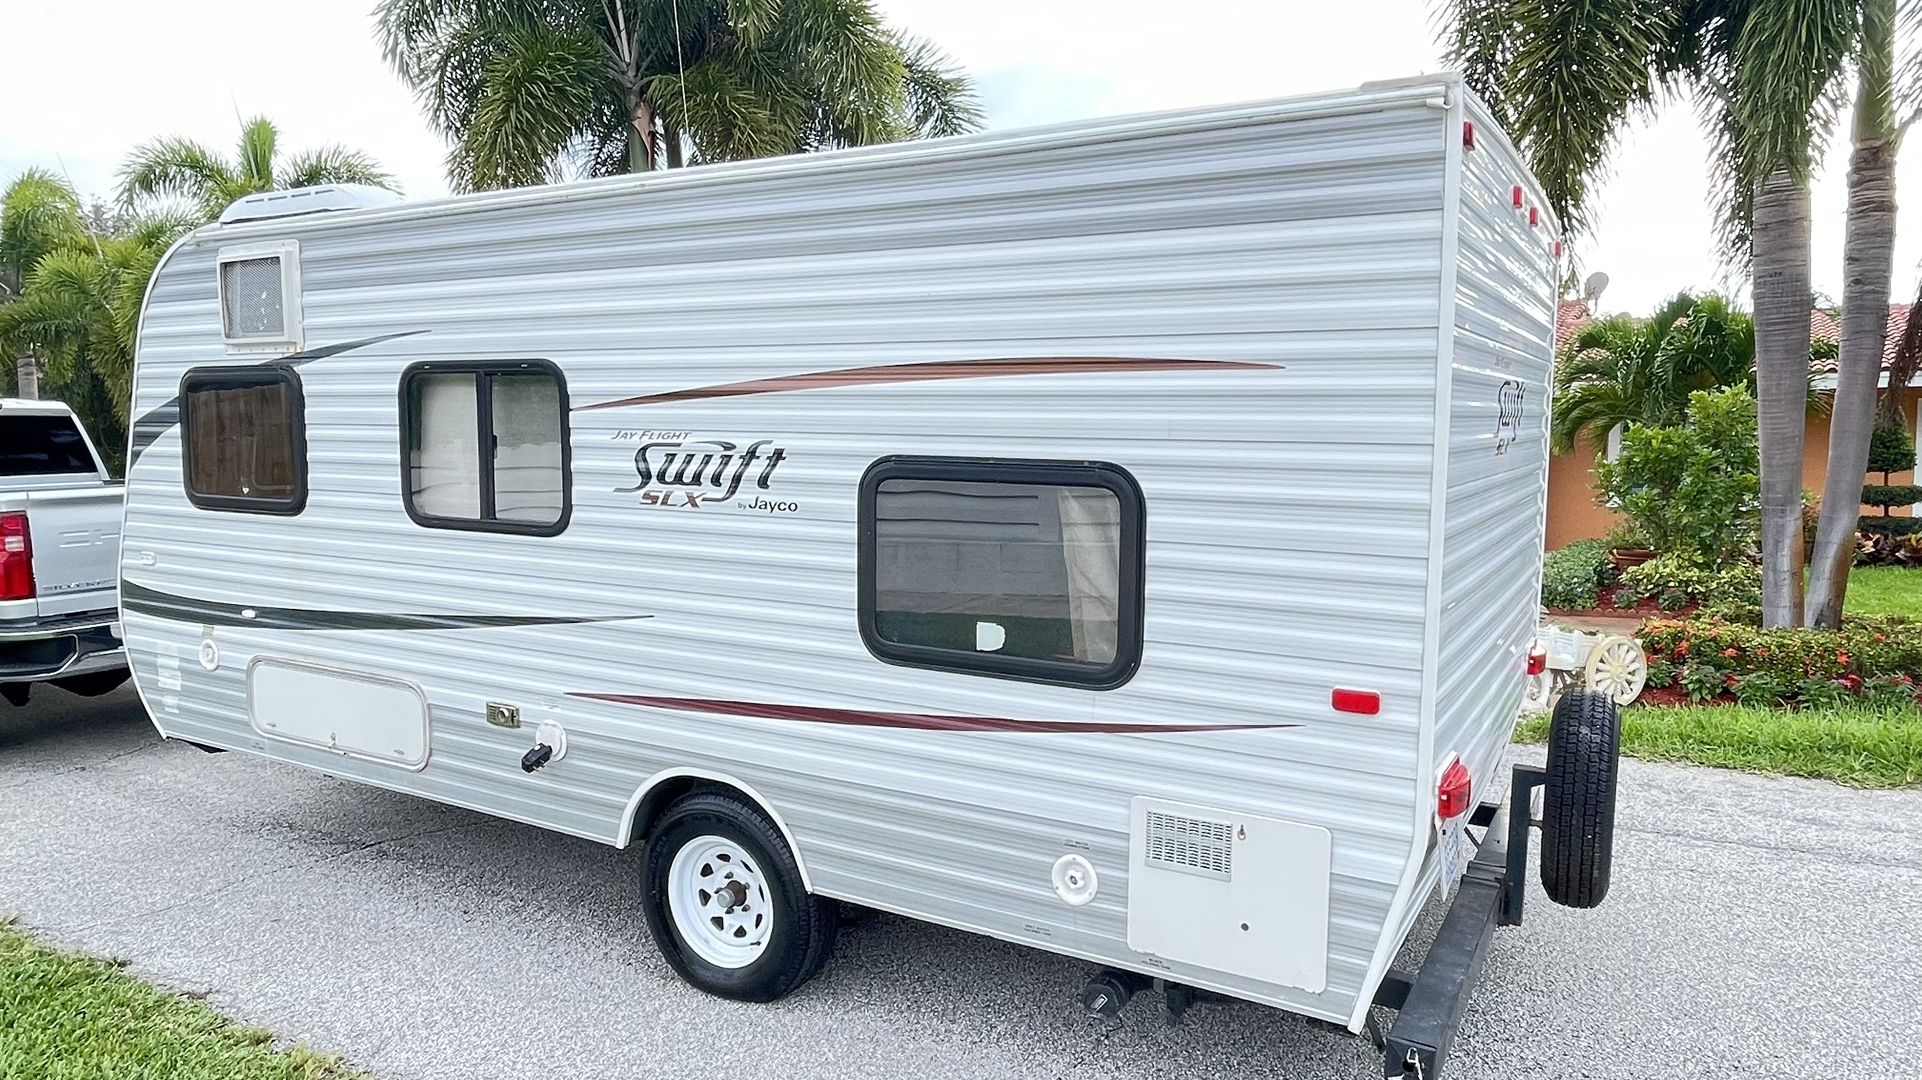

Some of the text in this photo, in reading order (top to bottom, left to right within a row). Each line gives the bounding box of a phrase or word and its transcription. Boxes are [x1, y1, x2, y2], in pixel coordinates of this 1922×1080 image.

[611, 430, 692, 440] JAY FLIGHT
[613, 440, 787, 502] Swift
[639, 490, 706, 508] SLX
[737, 496, 798, 513] by Jayco
